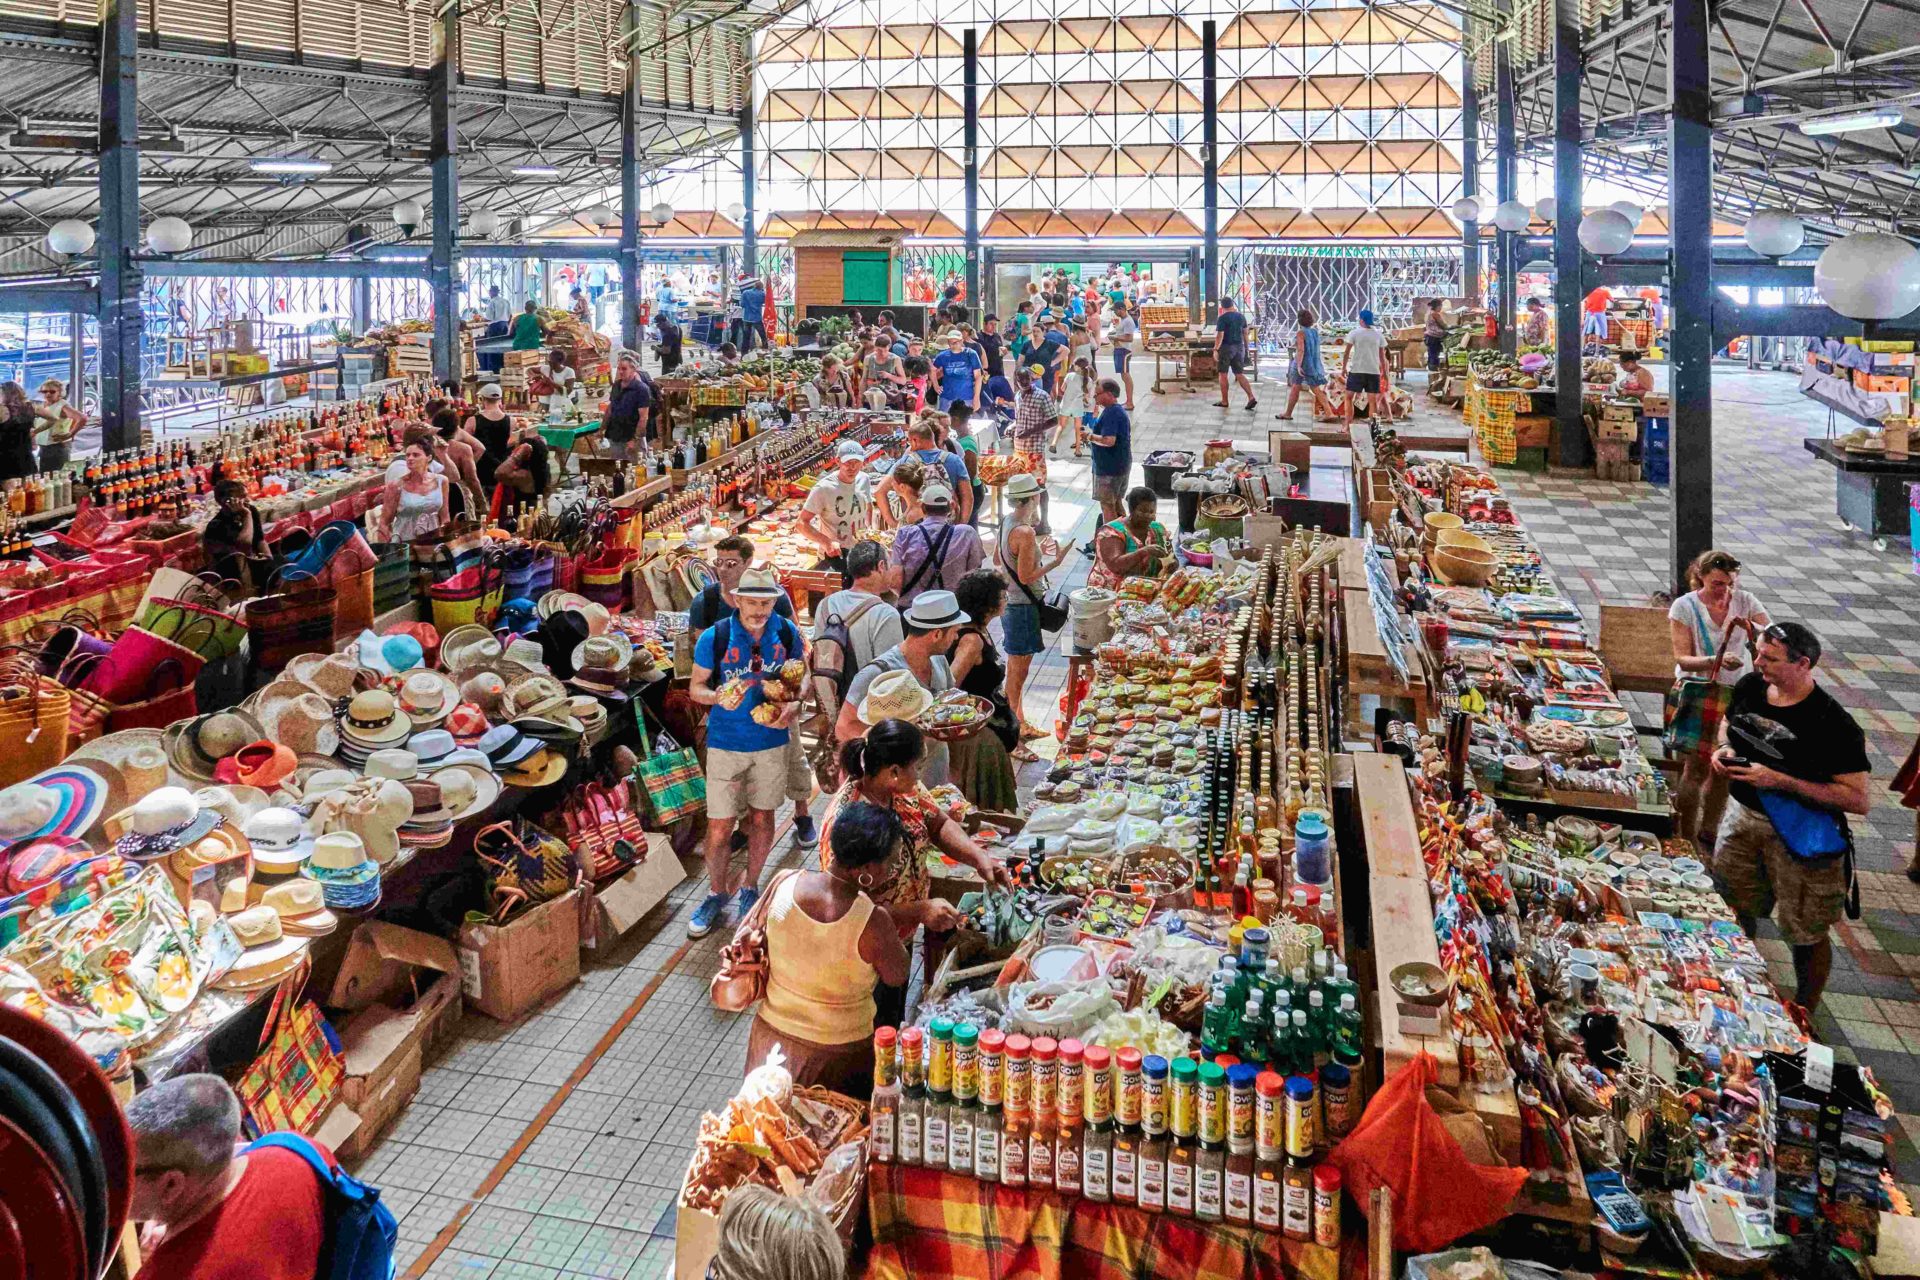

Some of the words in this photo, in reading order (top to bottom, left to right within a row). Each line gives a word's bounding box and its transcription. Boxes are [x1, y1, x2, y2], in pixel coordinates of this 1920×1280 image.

[723, 646, 740, 663] 19
[725, 658, 754, 681] Petrol
[1032, 1062, 1056, 1075] GOYA
[1060, 1065, 1083, 1077] GOYA
